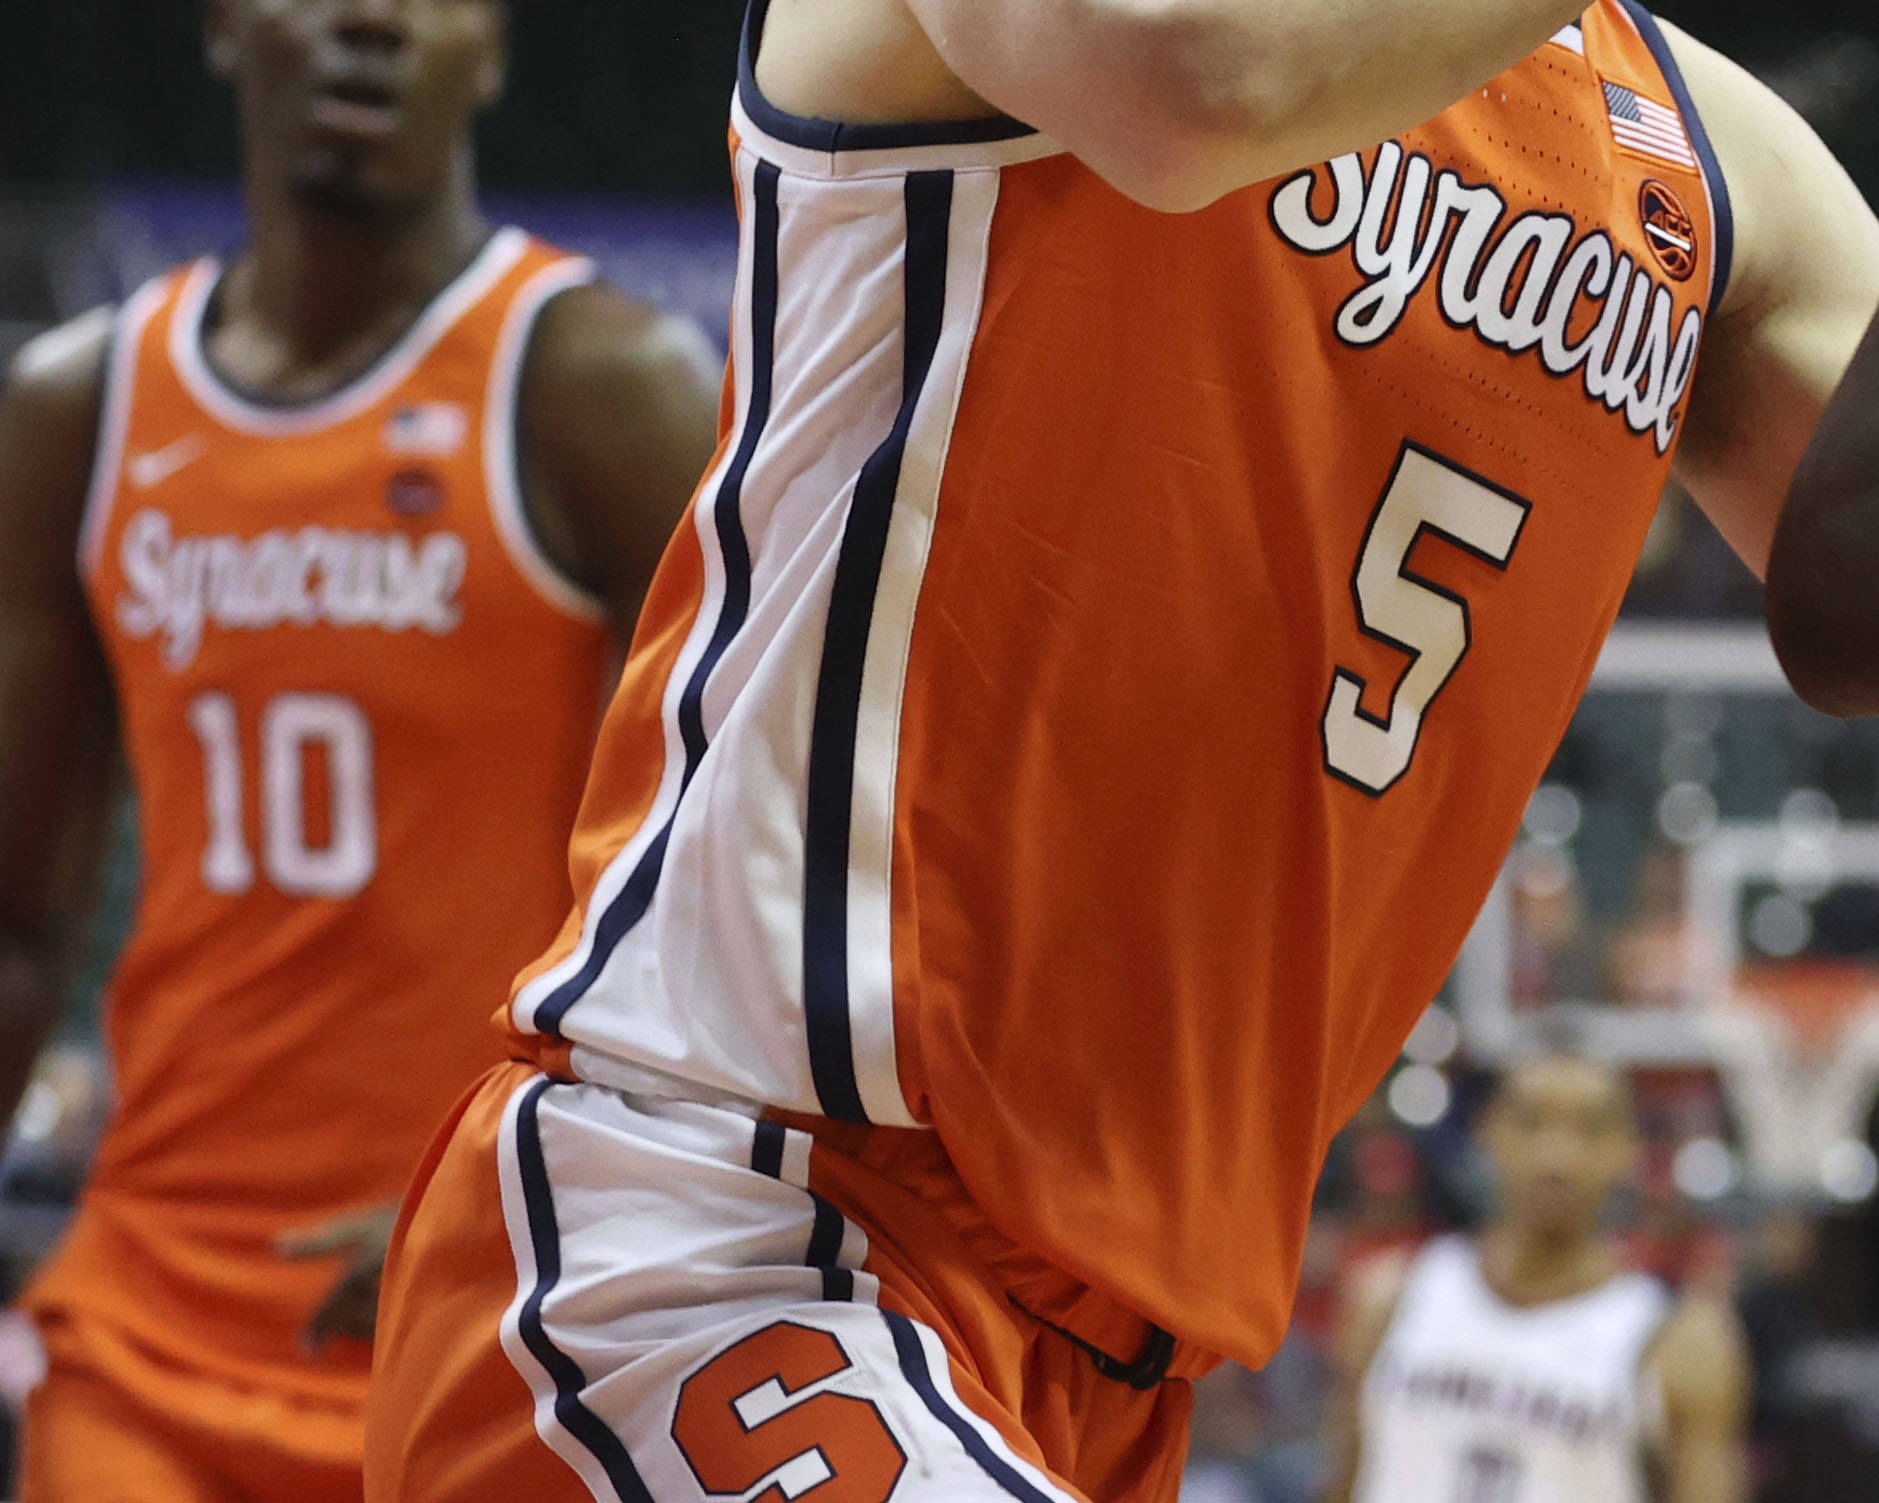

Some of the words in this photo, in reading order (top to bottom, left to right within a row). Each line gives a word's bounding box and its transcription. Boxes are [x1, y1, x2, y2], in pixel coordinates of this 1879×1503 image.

[117, 508, 468, 673] Syracuse
[1320, 438, 1533, 799] 5
[188, 688, 379, 899] 10
